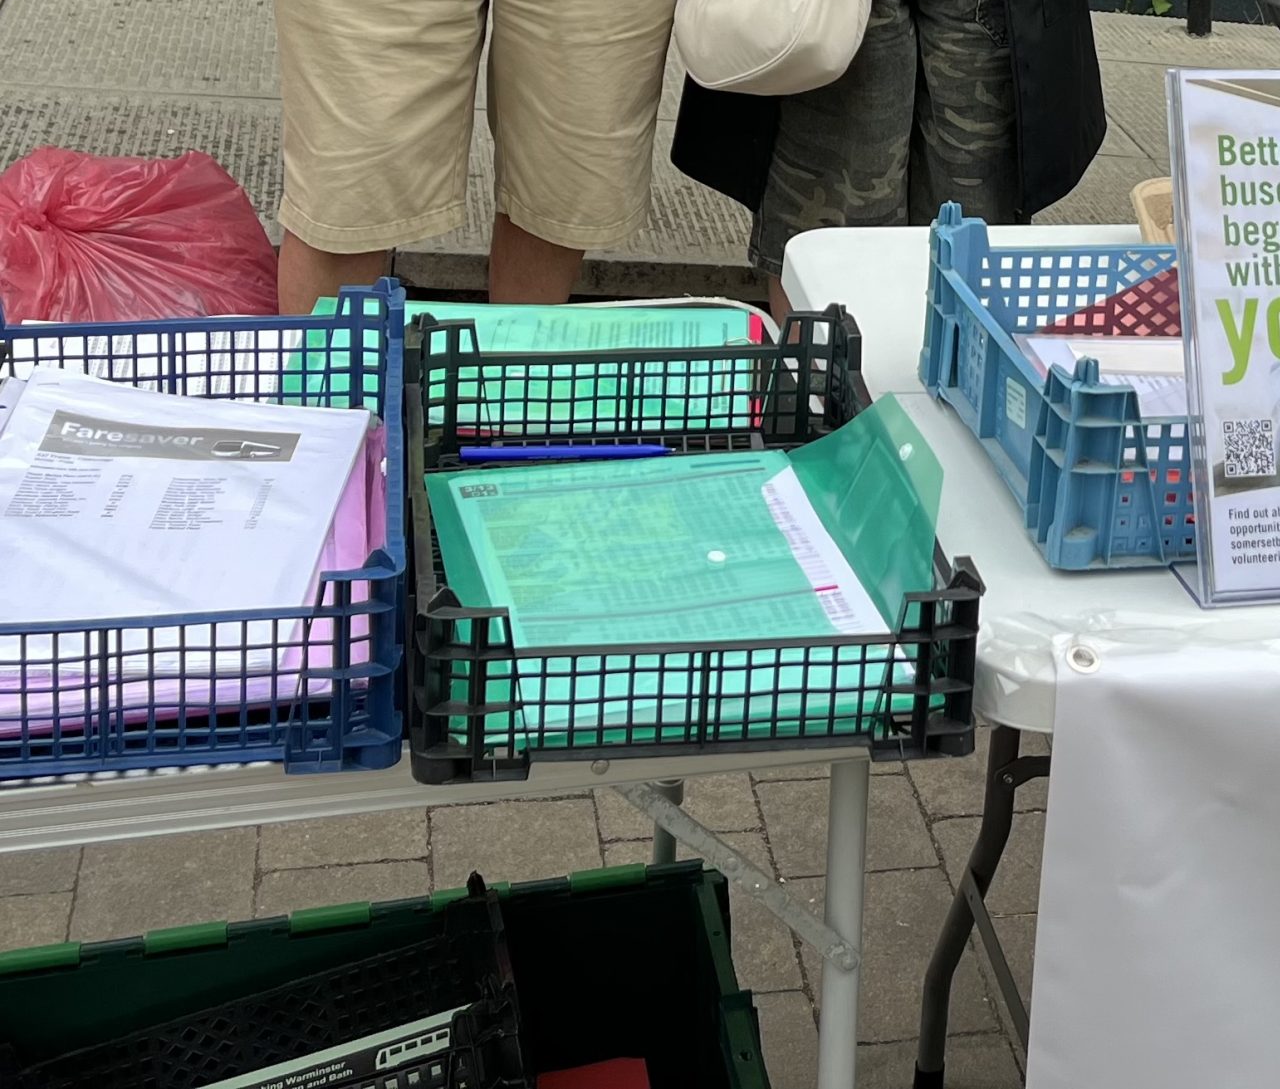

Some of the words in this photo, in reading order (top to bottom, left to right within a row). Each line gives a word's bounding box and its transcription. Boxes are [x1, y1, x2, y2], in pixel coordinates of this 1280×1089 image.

[60, 421, 205, 447] Faresaver
[1228, 508, 1250, 520] Find
[1253, 508, 1269, 518] out
[285, 1061, 346, 1086] Warminster
[307, 1077, 327, 1089] and
[329, 1068, 353, 1082] Bath
